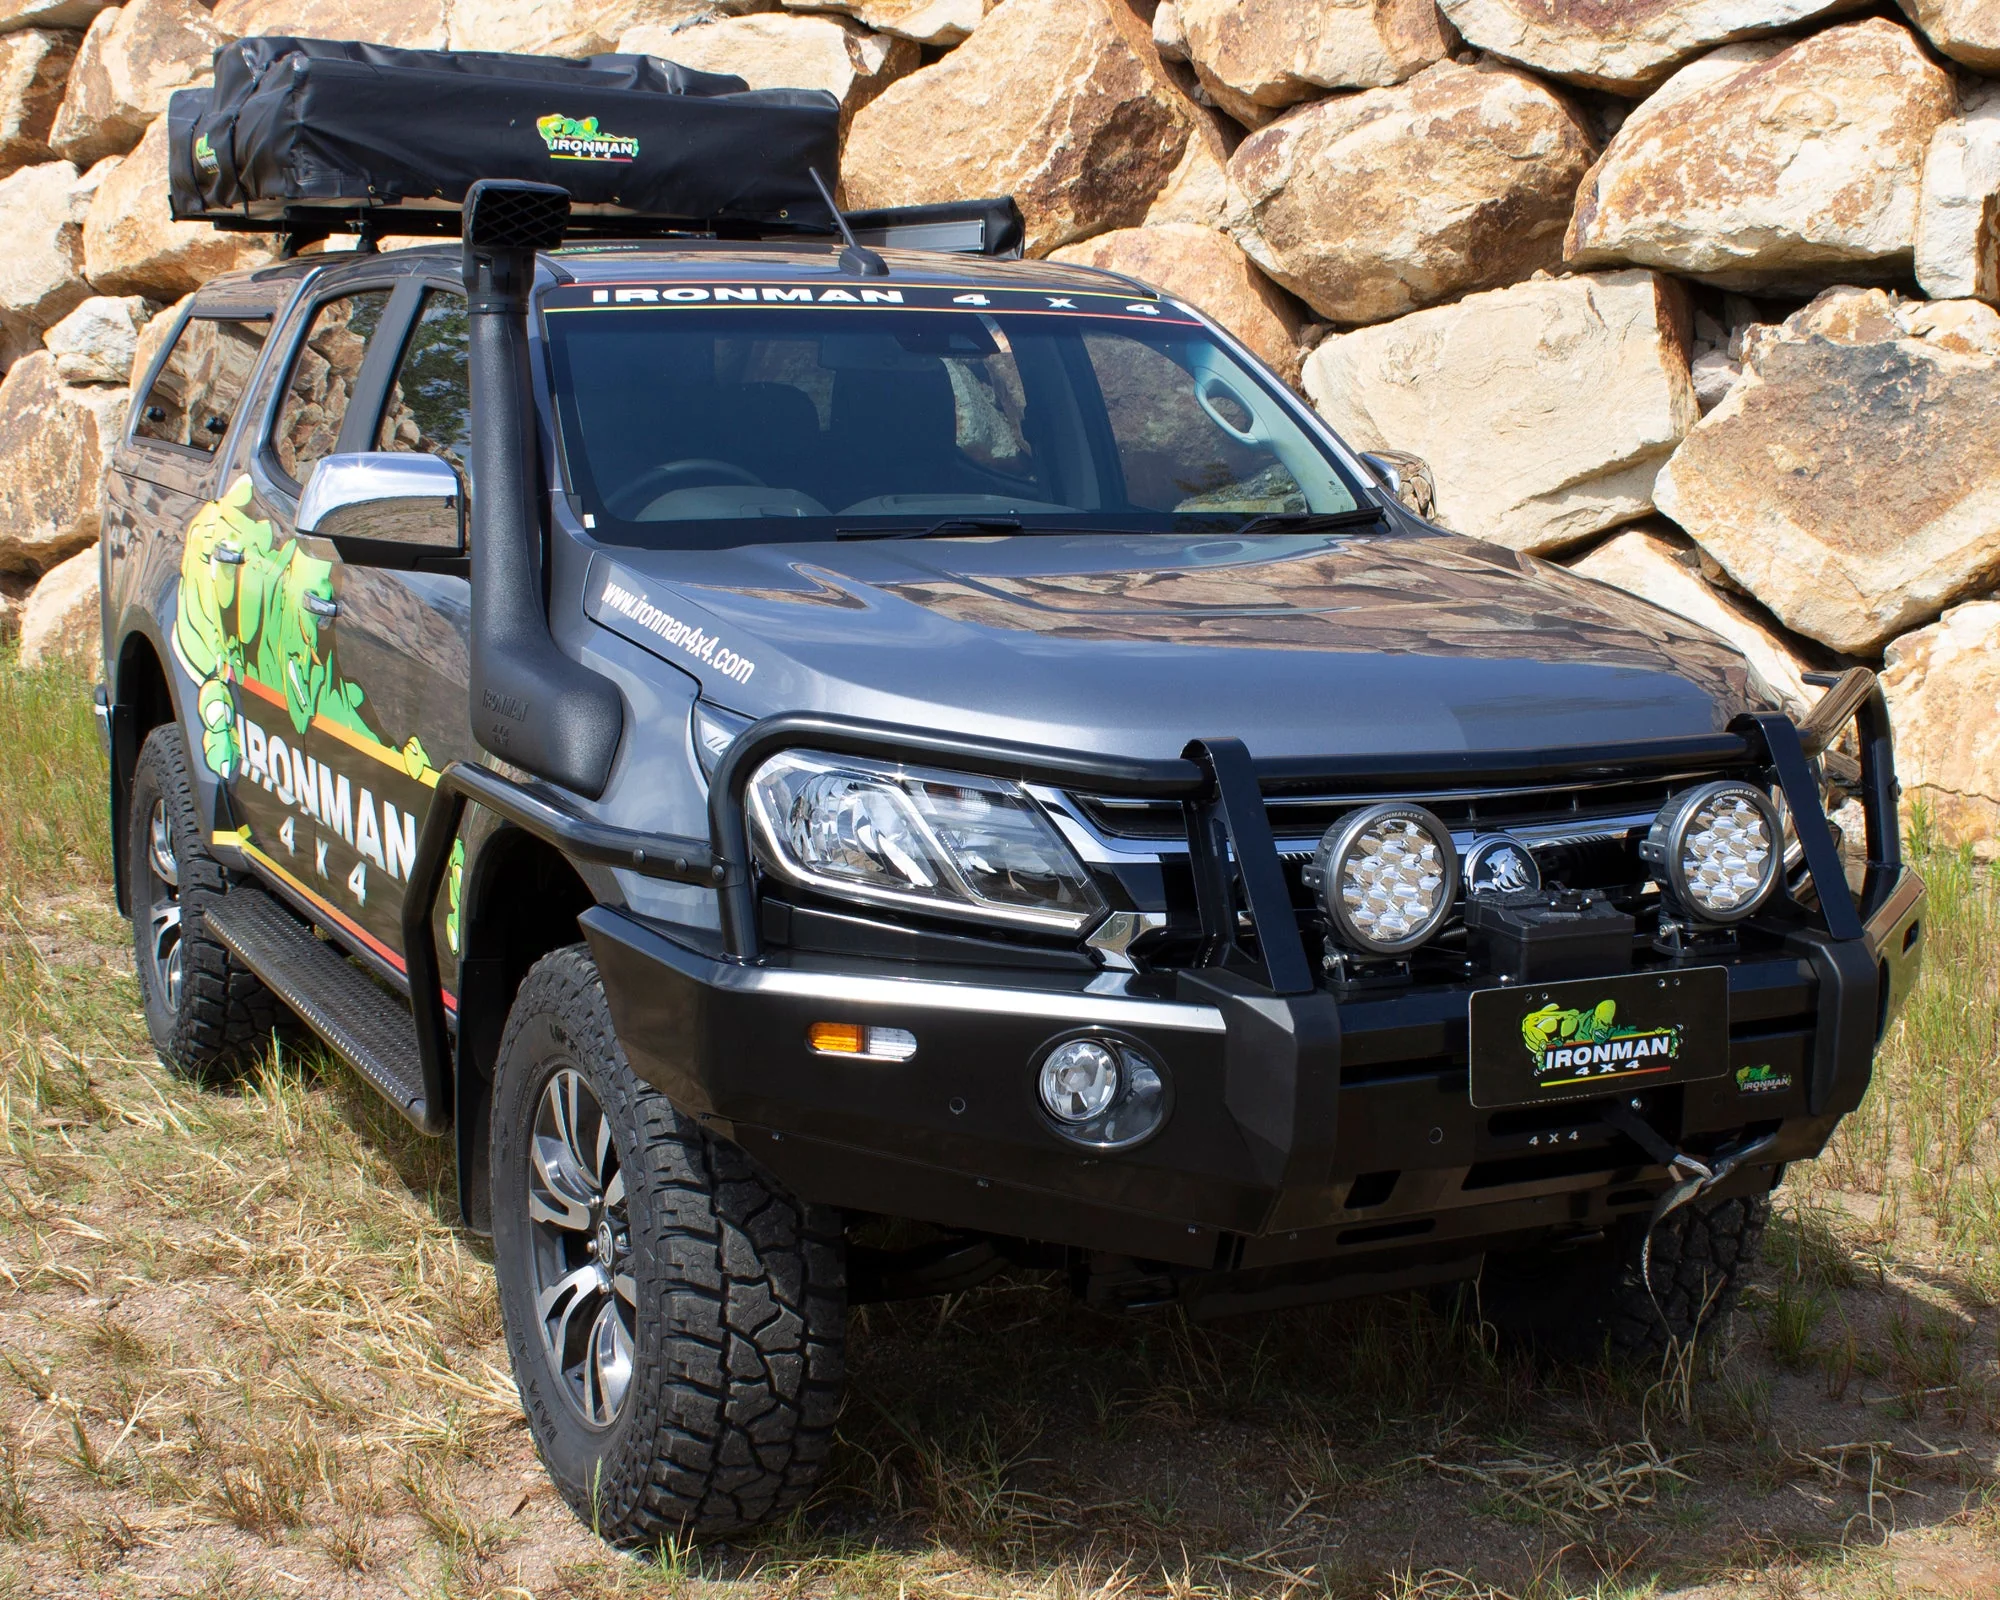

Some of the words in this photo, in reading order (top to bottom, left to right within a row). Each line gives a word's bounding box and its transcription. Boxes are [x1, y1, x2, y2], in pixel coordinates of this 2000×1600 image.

[553, 139, 633, 154] IRONMAN
[592, 287, 904, 303] IRONMAN
[953, 293, 990, 306] 4
[1125, 304, 1160, 315] 4
[601, 582, 755, 684] www.ironman4x4.com
[236, 713, 417, 884] IRONMAN
[1373, 811, 1408, 824] IRONMAN
[279, 815, 295, 857] 4
[348, 861, 367, 908] 4
[1546, 1037, 1670, 1069] IRONMAN
[1575, 1066, 1590, 1076] 4
[1625, 1060, 1640, 1069] 4
[1743, 1078, 1788, 1090] IRONMAN
[1528, 1136, 1539, 1146] 4
[1568, 1131, 1579, 1140] 4
